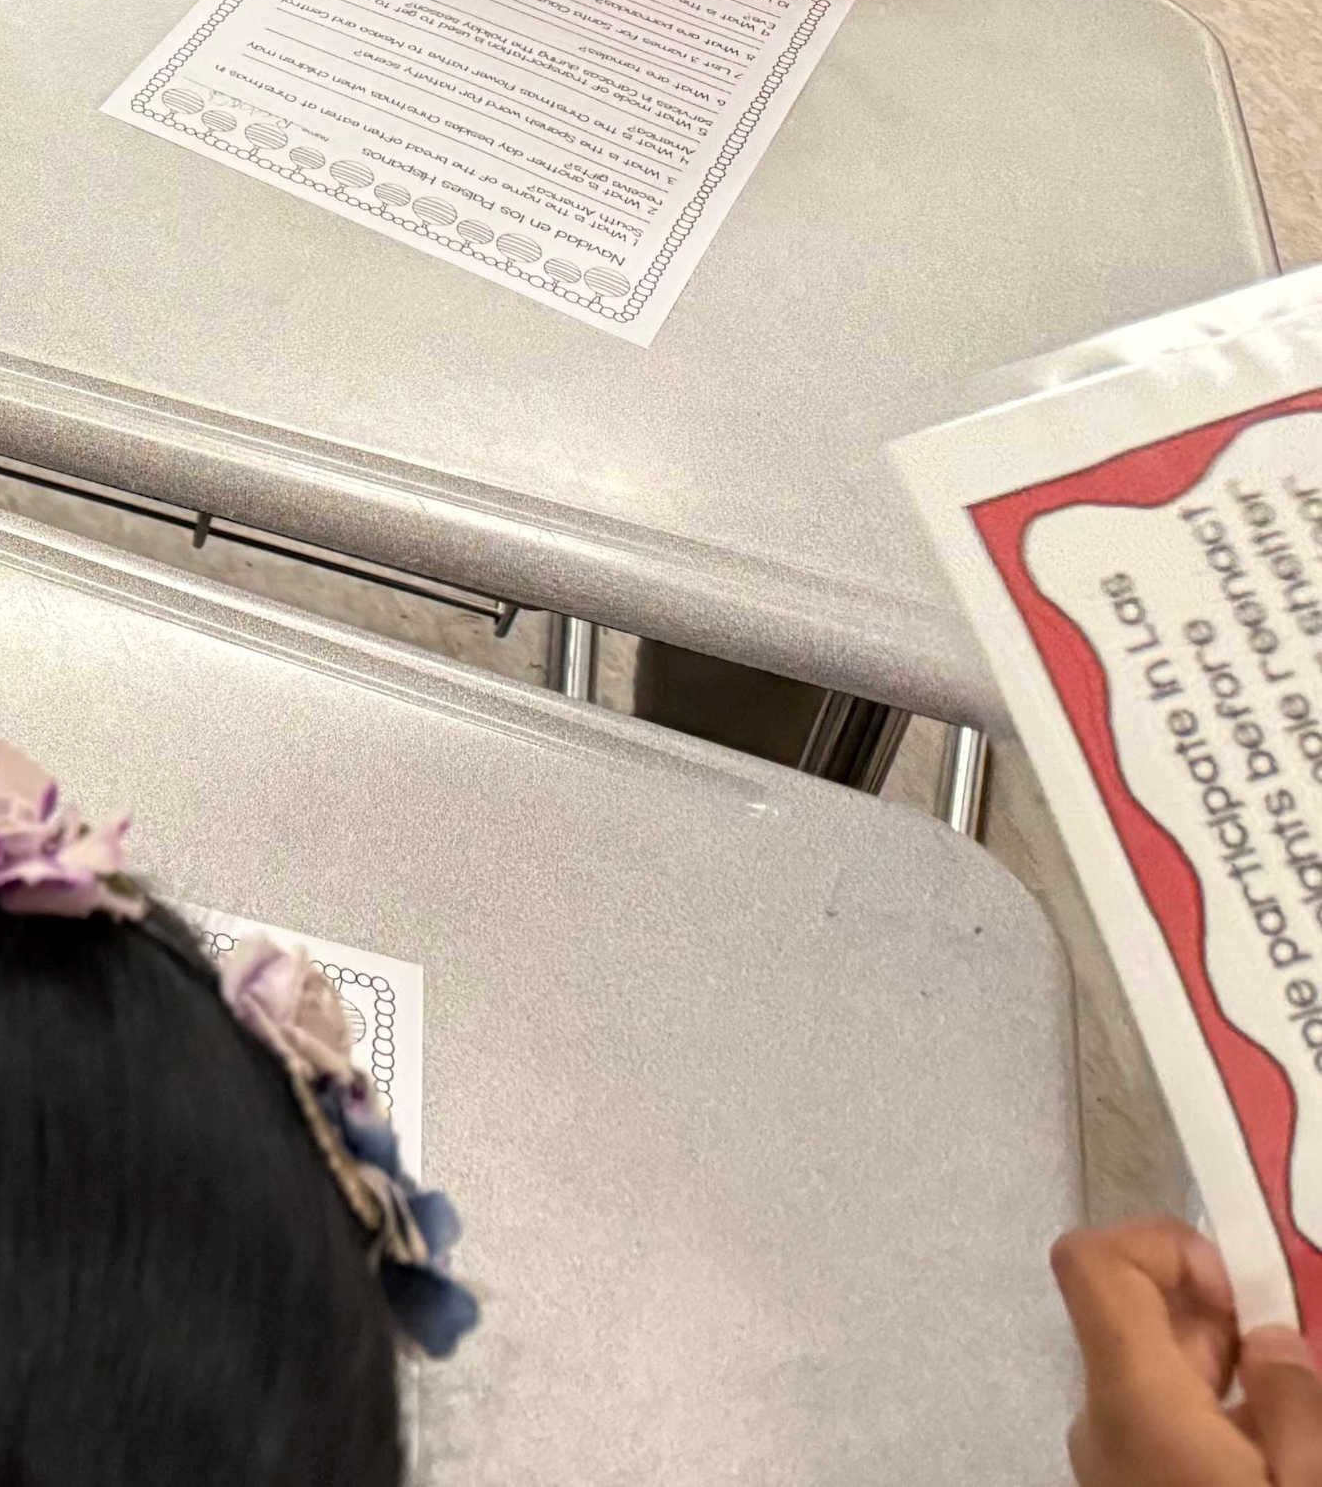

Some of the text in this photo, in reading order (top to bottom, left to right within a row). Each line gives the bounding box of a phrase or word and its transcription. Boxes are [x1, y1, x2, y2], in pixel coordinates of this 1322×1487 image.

[1097, 573, 1163, 654] Las
[1175, 502, 1292, 686] reenact
[1144, 657, 1183, 702] in
[1181, 619, 1279, 784] before
[1165, 708, 1308, 970] participate
